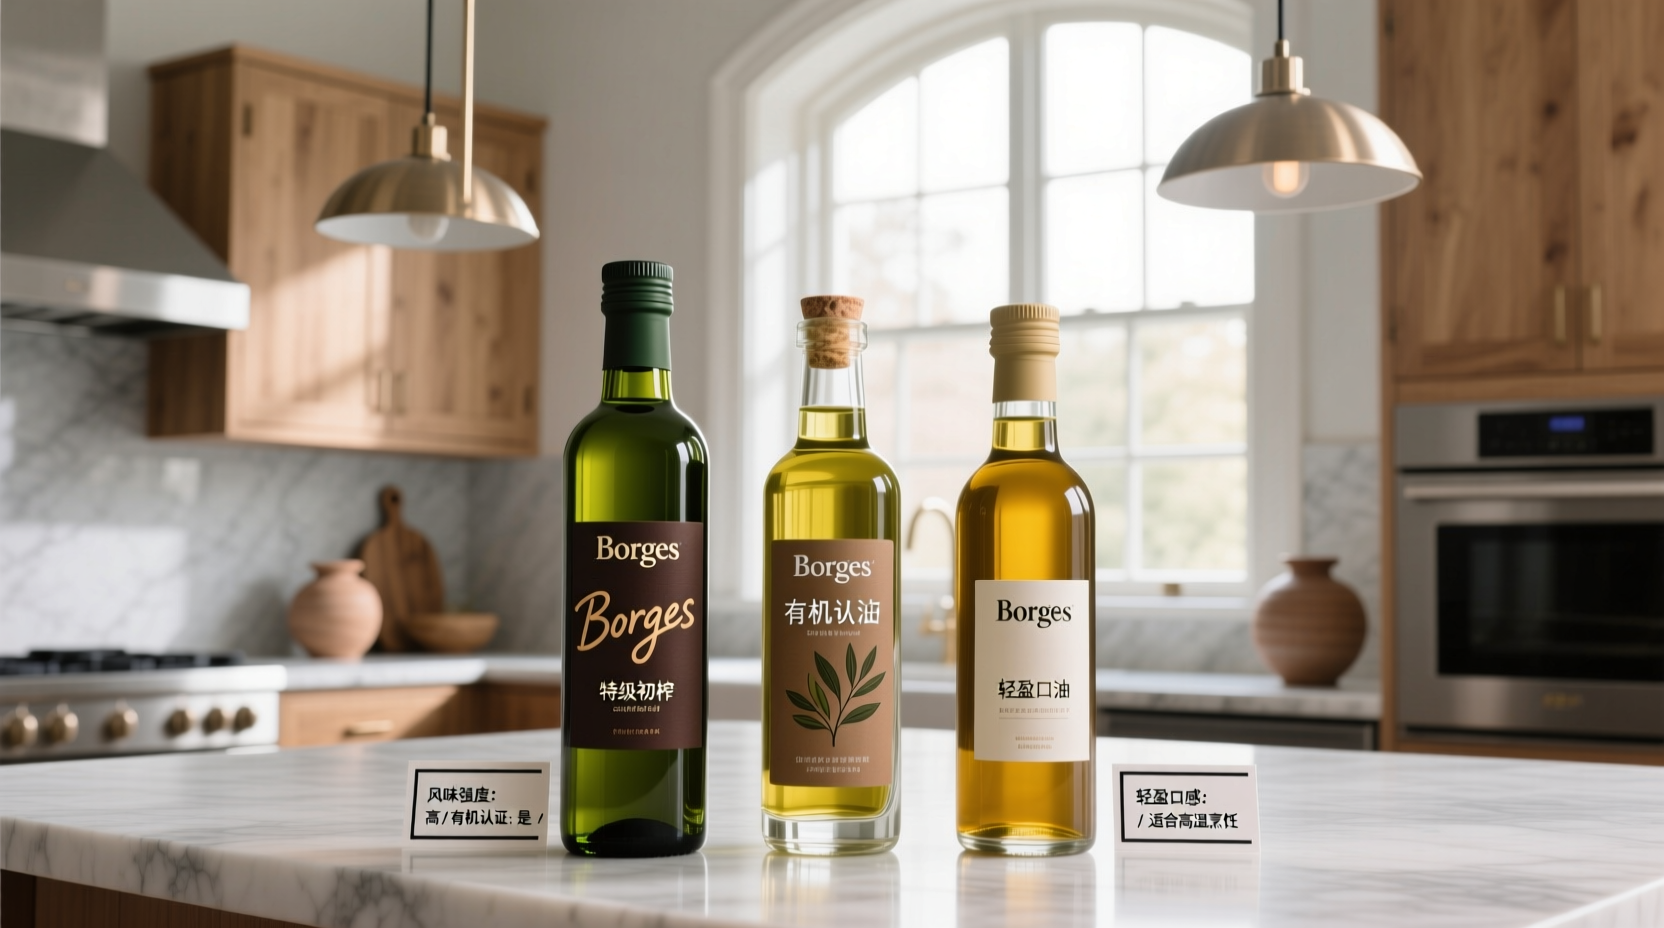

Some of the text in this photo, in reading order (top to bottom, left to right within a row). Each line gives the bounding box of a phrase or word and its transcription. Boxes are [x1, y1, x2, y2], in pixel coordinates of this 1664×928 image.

[596, 535, 680, 568] Borges
[793, 554, 872, 584] Borges
[784, 598, 880, 625] 有机认油
[996, 599, 1072, 629] Borges
[574, 590, 695, 665] Borges
[599, 680, 675, 701] 特级初榨
[998, 678, 1070, 699] 轻盈口油
